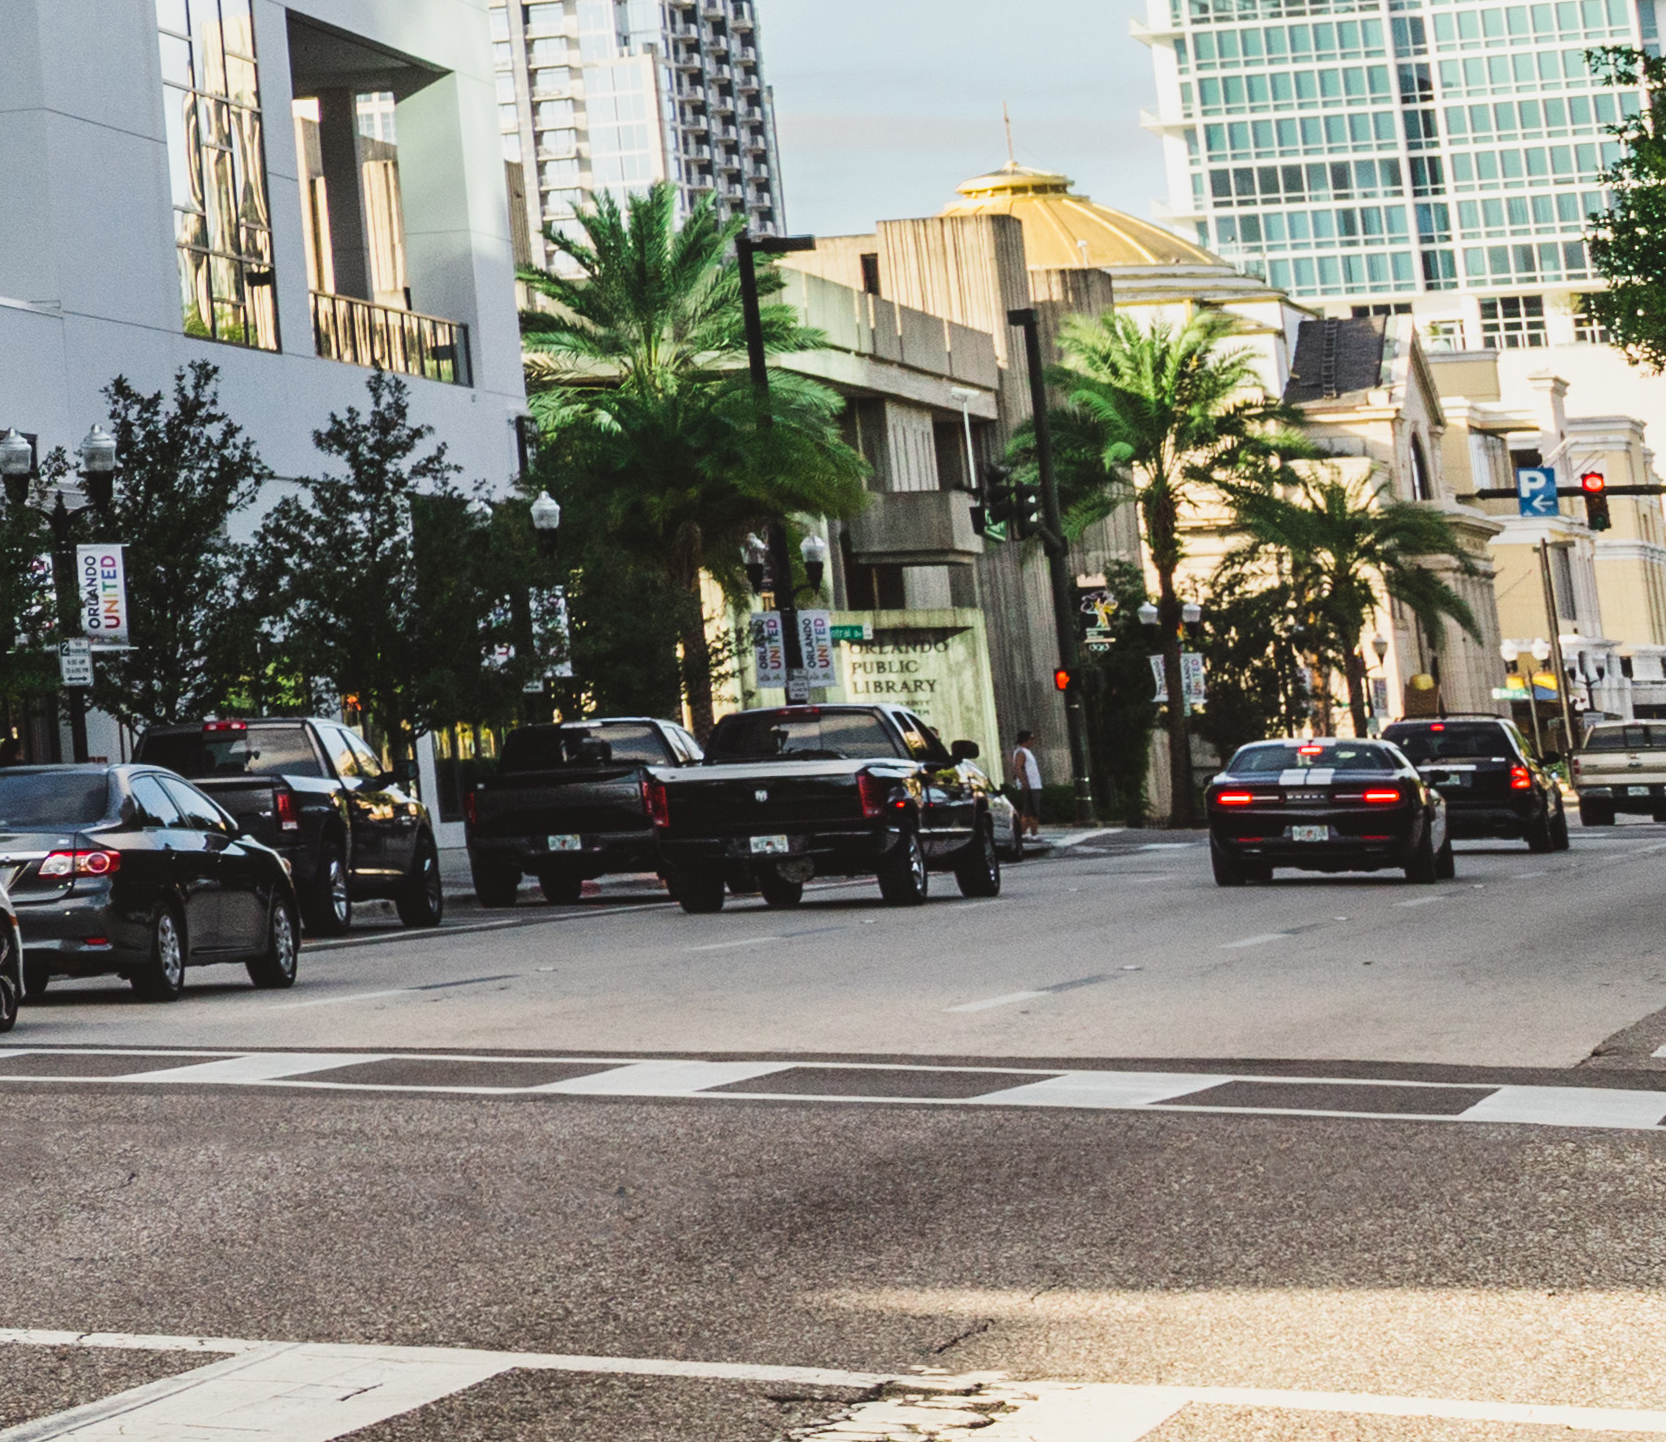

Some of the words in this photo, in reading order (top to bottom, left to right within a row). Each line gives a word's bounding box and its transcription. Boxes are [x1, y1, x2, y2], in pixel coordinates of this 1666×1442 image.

[1518, 470, 1547, 498] P
[84, 556, 101, 629] ORLANDO
[100, 556, 121, 629] UNITED
[802, 618, 817, 669] ORLANDO
[814, 618, 830, 669] UNITED
[849, 641, 948, 655] ORLANDO
[852, 660, 919, 674] PUBLIC
[853, 679, 937, 694] LIBRARY
